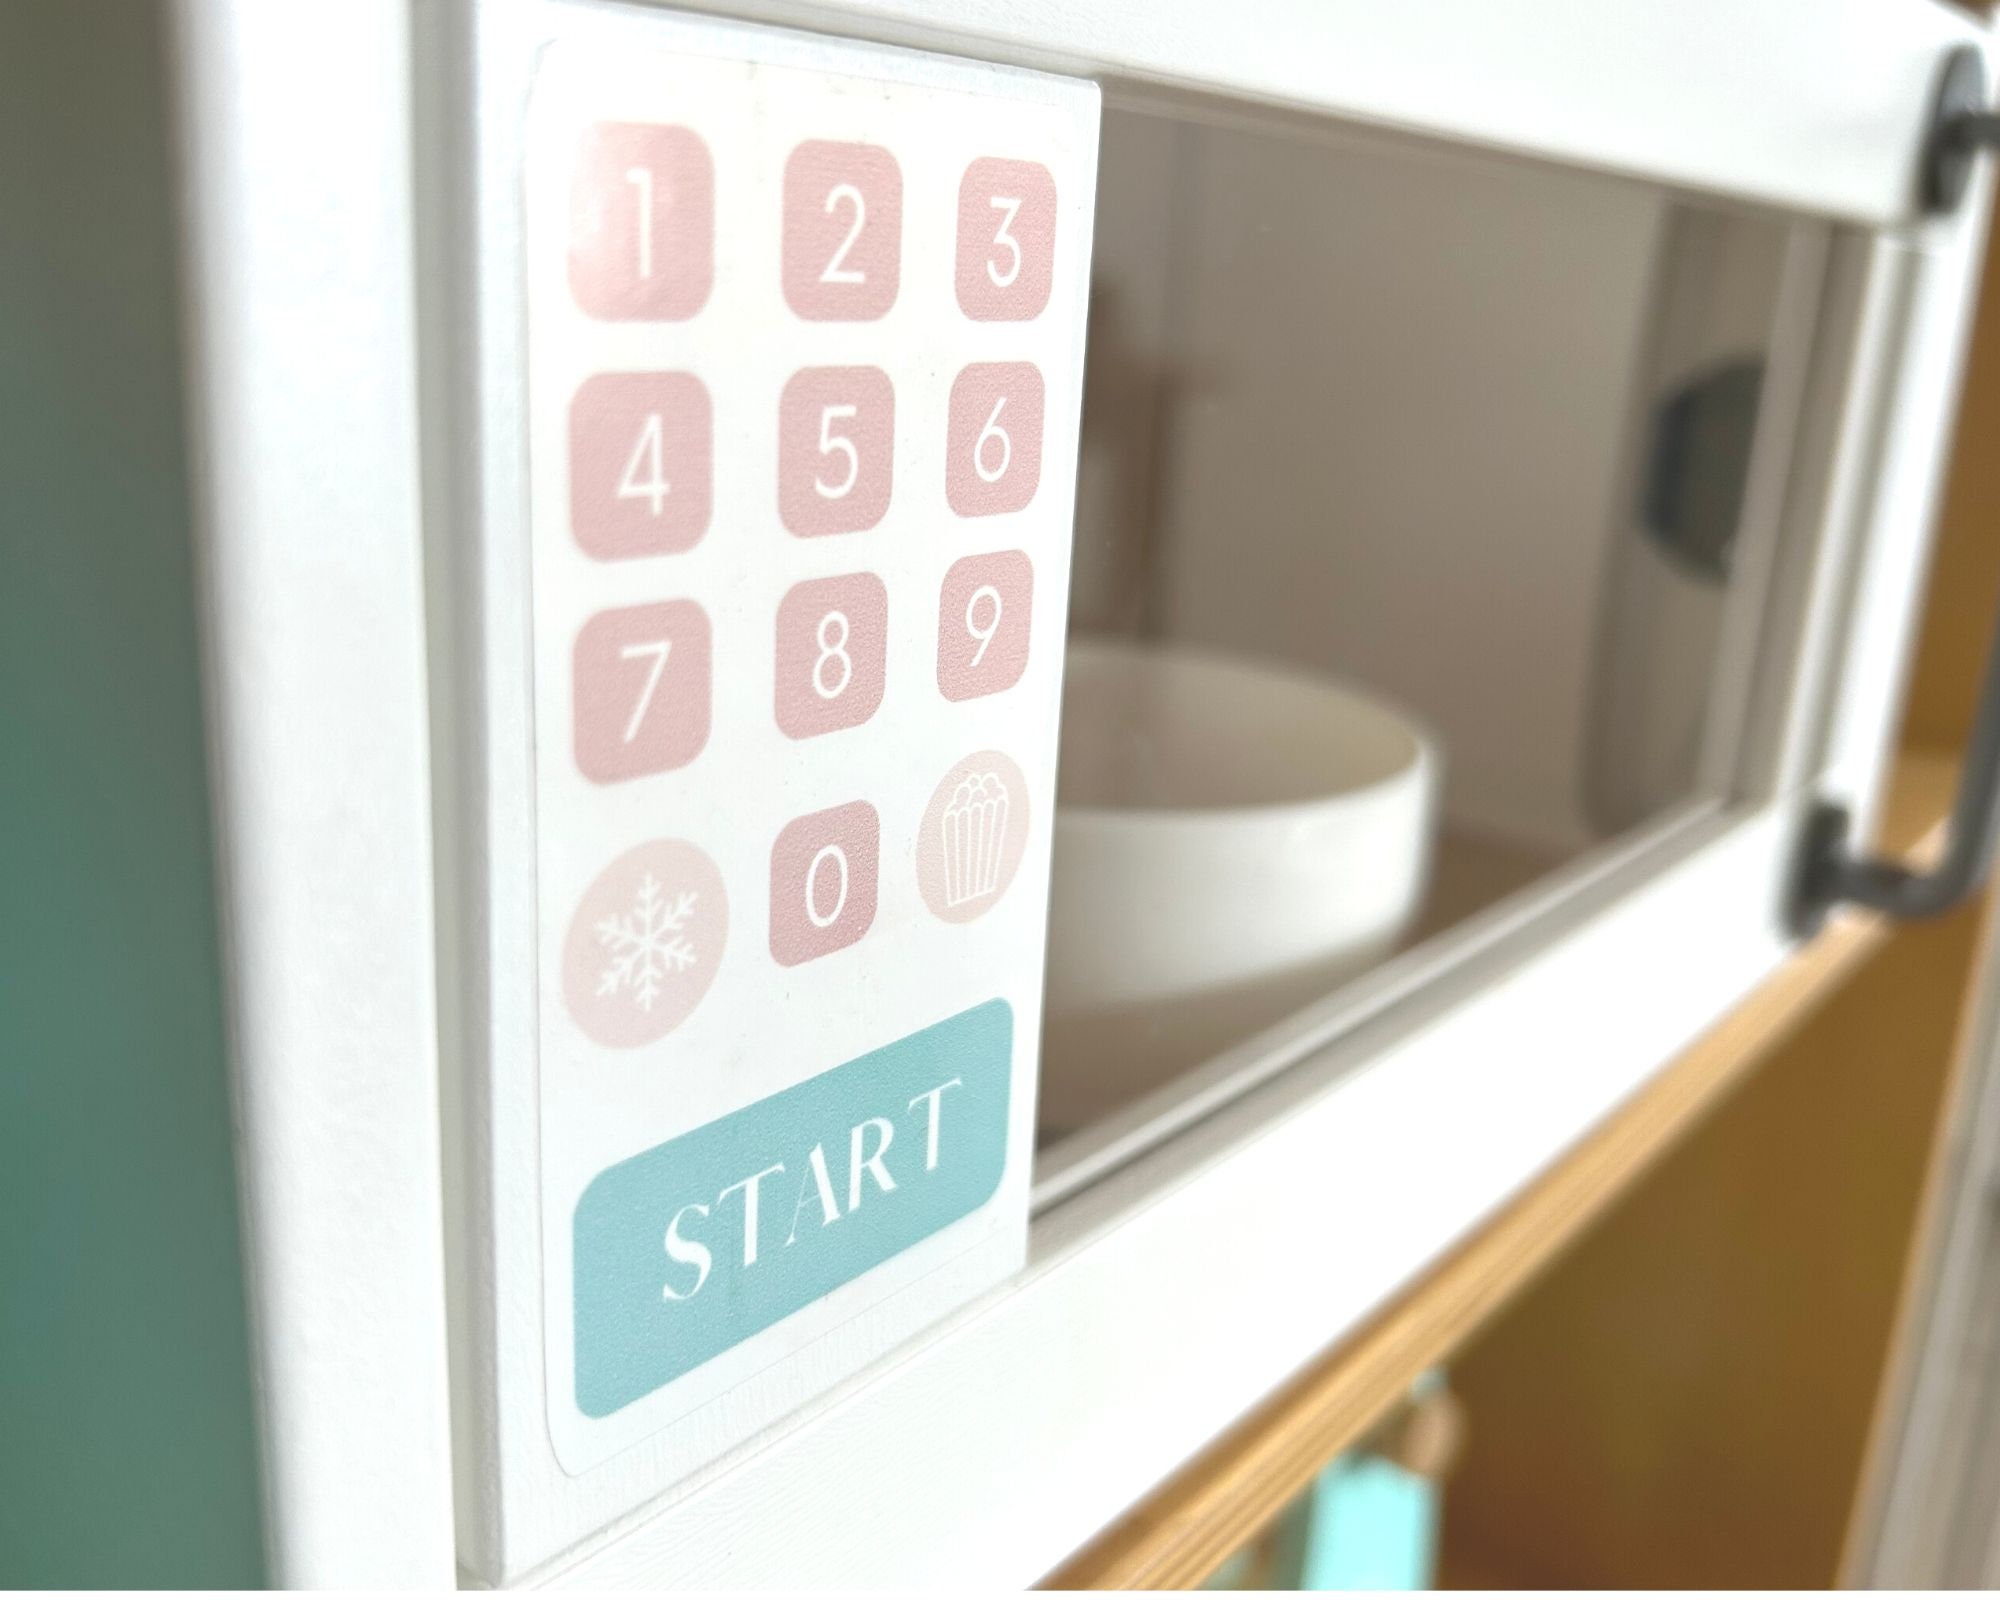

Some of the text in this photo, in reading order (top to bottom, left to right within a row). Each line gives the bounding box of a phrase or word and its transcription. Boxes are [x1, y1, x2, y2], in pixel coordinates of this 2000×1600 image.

[626, 167, 653, 281] 1
[818, 183, 867, 284] 2
[986, 196, 1023, 288] 3
[616, 413, 671, 517] 4
[814, 404, 859, 500] 5
[973, 396, 1012, 483] 6
[812, 610, 853, 699] 8
[965, 585, 1003, 668] 9
[621, 640, 673, 744] 7
[805, 844, 849, 928] 0
[661, 1077, 963, 1303] START
